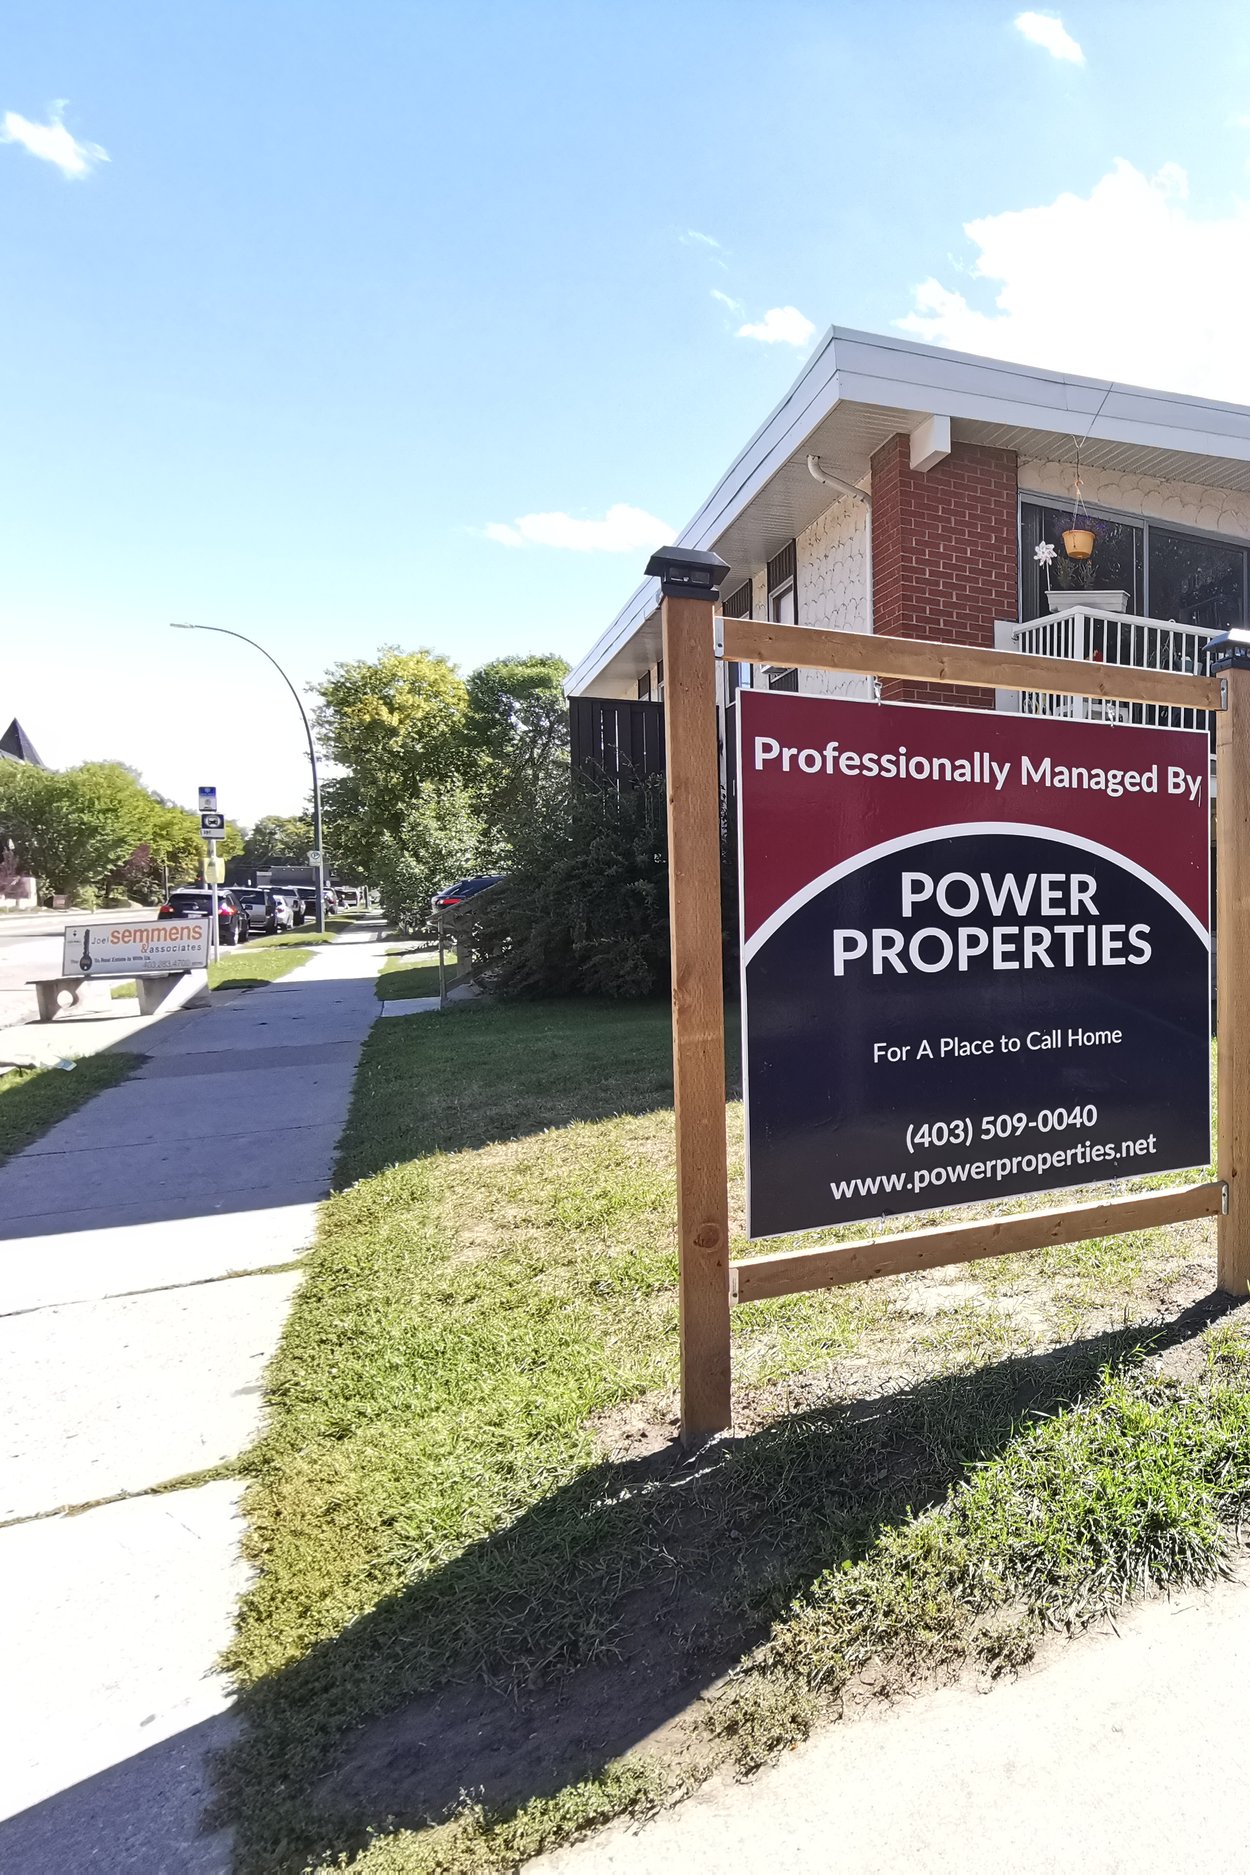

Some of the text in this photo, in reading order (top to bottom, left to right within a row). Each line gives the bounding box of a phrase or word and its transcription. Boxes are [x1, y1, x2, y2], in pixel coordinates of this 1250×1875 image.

[754, 736, 1202, 801] Professionally Managed By
[900, 871, 1100, 918] POWER
[91, 936, 109, 945] Joel
[110, 924, 203, 945] semmens
[833, 923, 1152, 977] PROPERTIES
[873, 1027, 1123, 1064] For A Place to Call Home
[906, 1104, 1098, 1154] (403) 509-0040
[829, 1132, 1157, 1200] www.powerproperties.net
